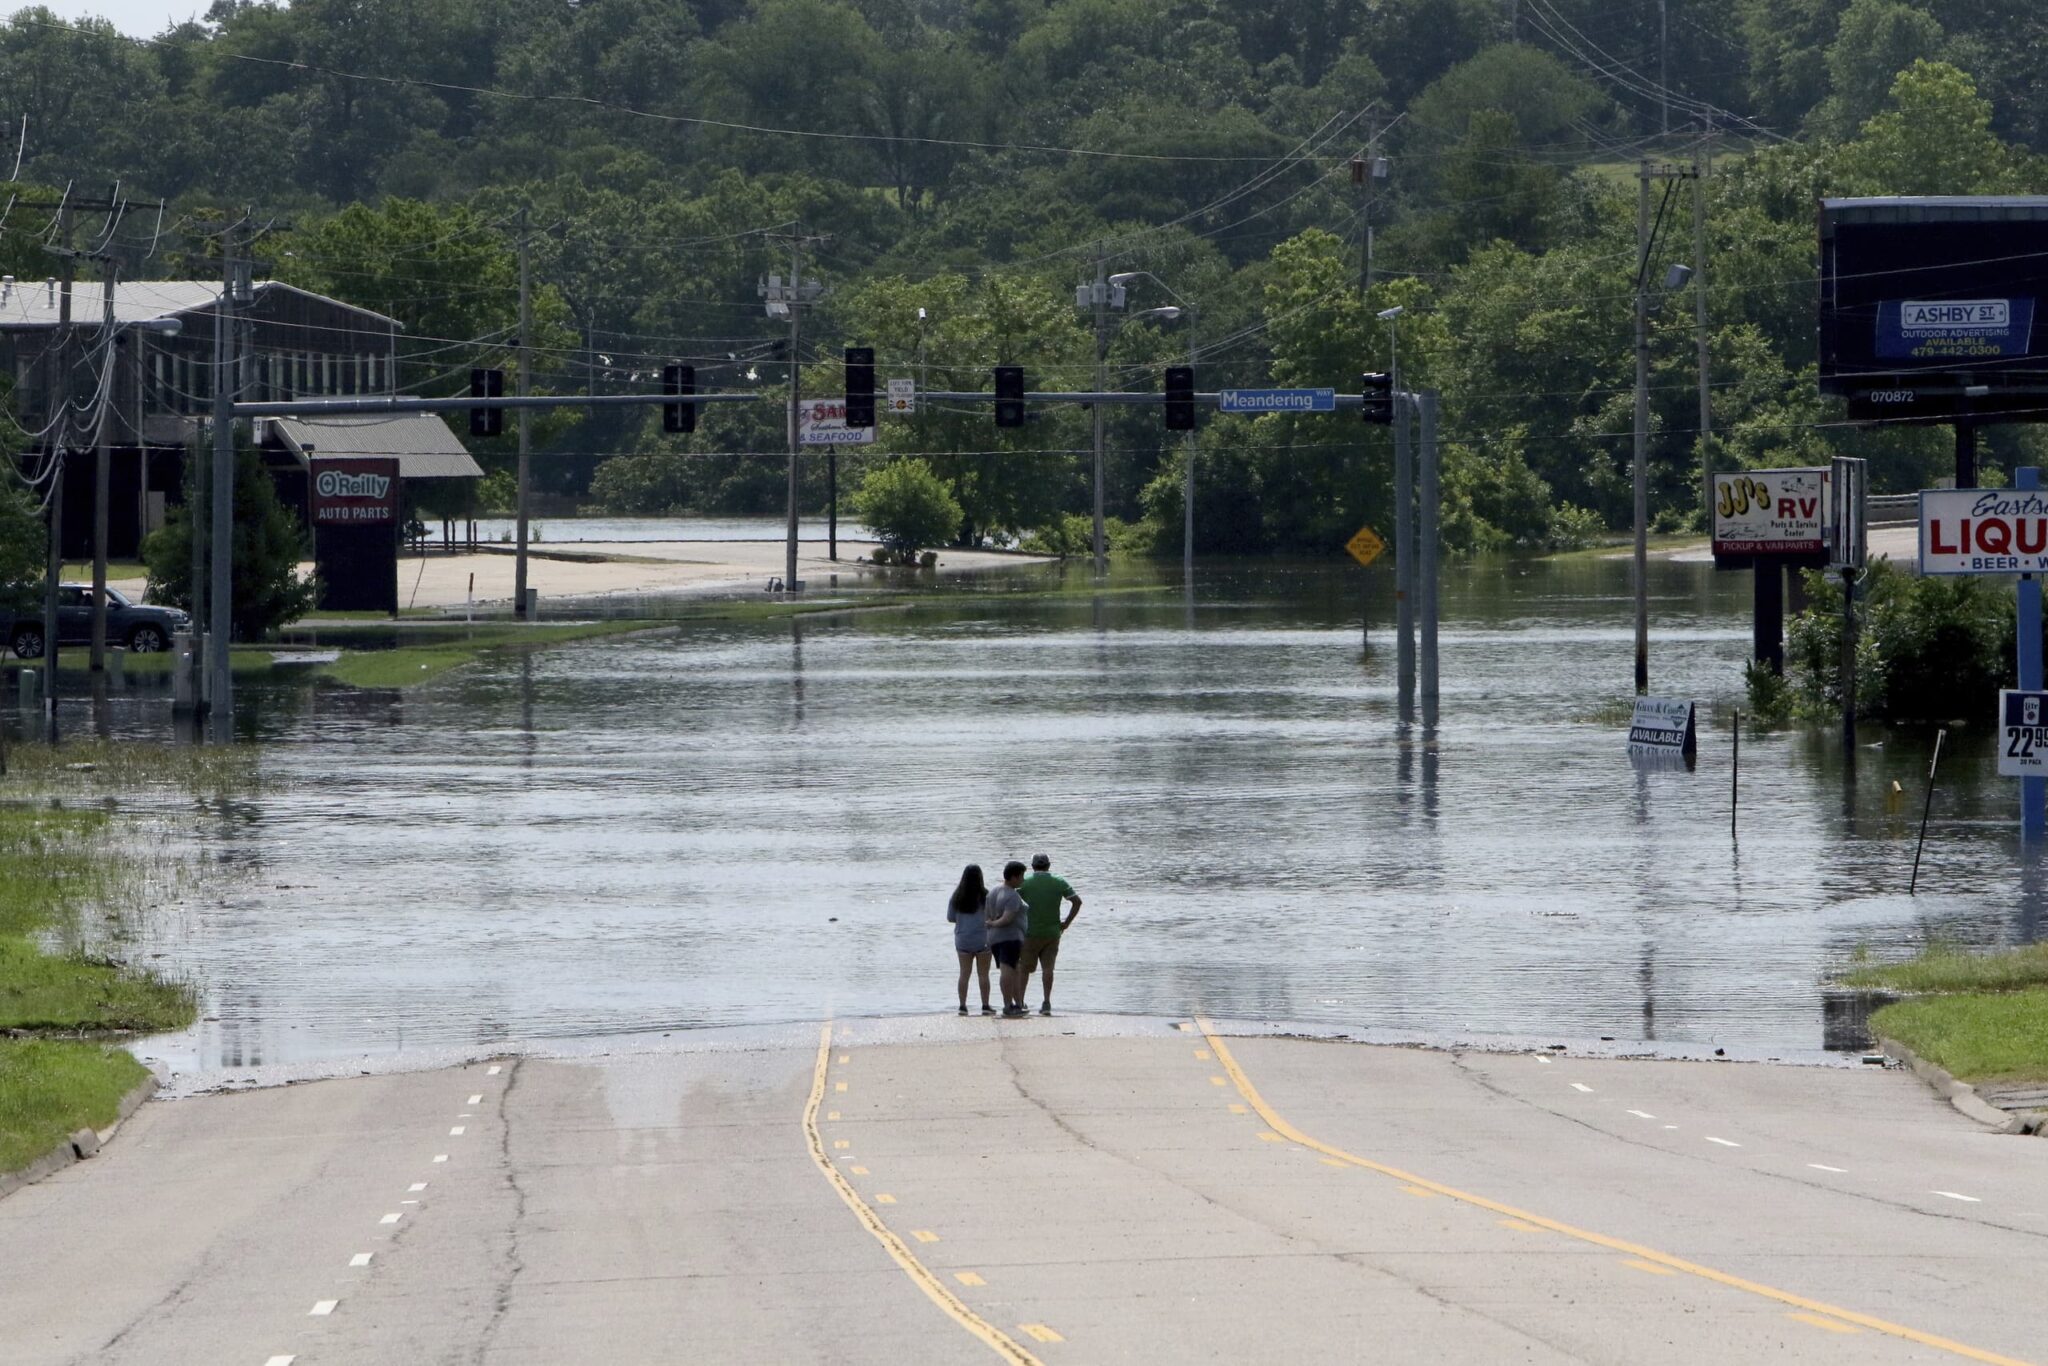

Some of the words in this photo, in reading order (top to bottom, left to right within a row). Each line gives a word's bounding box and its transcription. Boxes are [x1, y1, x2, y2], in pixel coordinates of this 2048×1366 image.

[1914, 306, 1975, 323] ASHBY
[1979, 306, 1996, 318] ST.
[1901, 329, 1948, 338] OUTDOOR
[1950, 328, 2010, 337] ADVERTISING
[1925, 337, 1986, 346] AVAILABLE
[1911, 345, 2001, 357] 479-442-0300
[1222, 391, 1313, 409] Meandering
[1315, 389, 1331, 397] WAY
[1871, 391, 1914, 403] 070872
[809, 432, 863, 441] SEAFOOD
[317, 471, 390, 498] O'Reilly
[318, 507, 349, 520] AUTO
[352, 506, 389, 519] PARTS
[1777, 497, 1818, 519] RV
[1770, 520, 1787, 529] Parts
[1795, 520, 1818, 528] Service
[1784, 528, 1805, 537] Center
[1930, 517, 2048, 556] LIQU
[1722, 542, 1755, 551] PICKUP
[1756, 542, 1763, 550] &
[1765, 541, 1784, 550] VAN
[1785, 541, 1814, 550] PARTS
[1972, 557, 2018, 569] BEER
[1631, 729, 1683, 744] AVAILABLE
